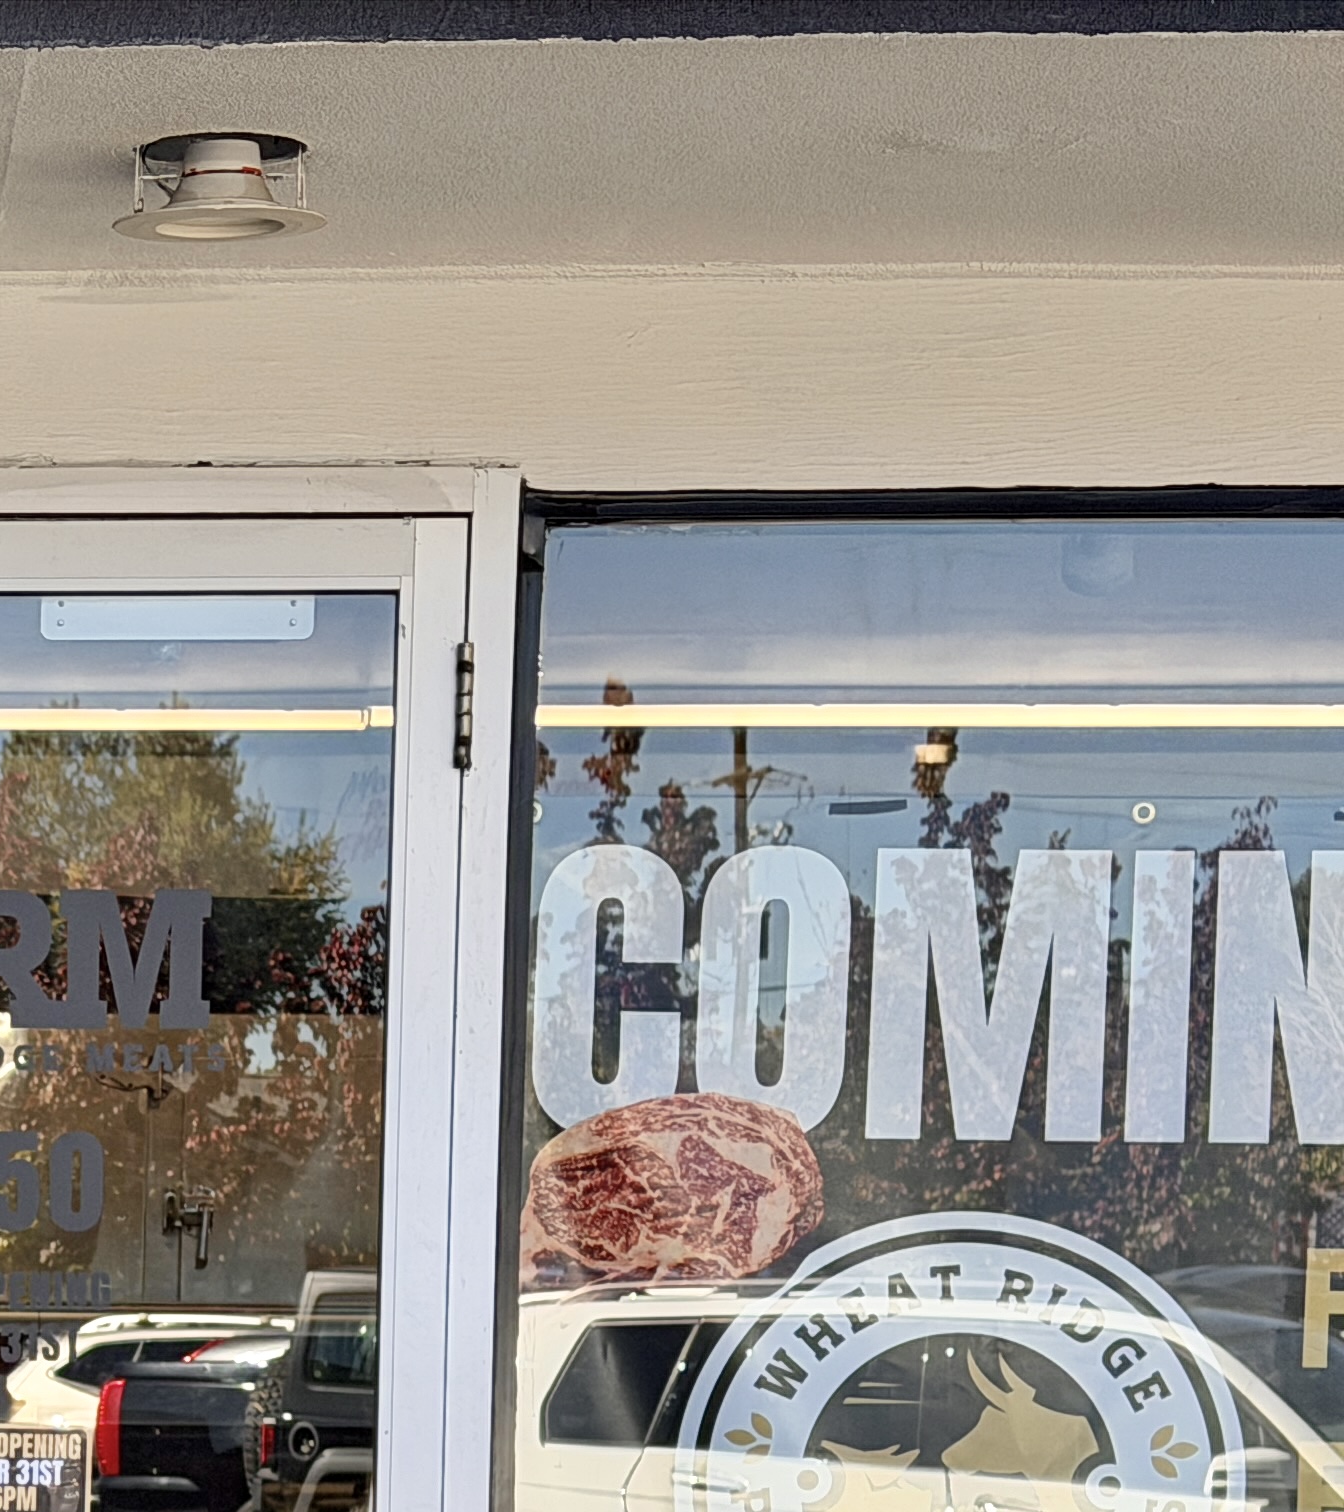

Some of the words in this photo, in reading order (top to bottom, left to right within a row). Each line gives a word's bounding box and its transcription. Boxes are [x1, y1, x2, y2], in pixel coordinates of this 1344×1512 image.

[85, 1044, 227, 1073] MEATS
[754, 1264, 962, 1400] WHEAT
[996, 1268, 1172, 1413] RIDGE
[16, 1459, 64, 1486] 31ST
